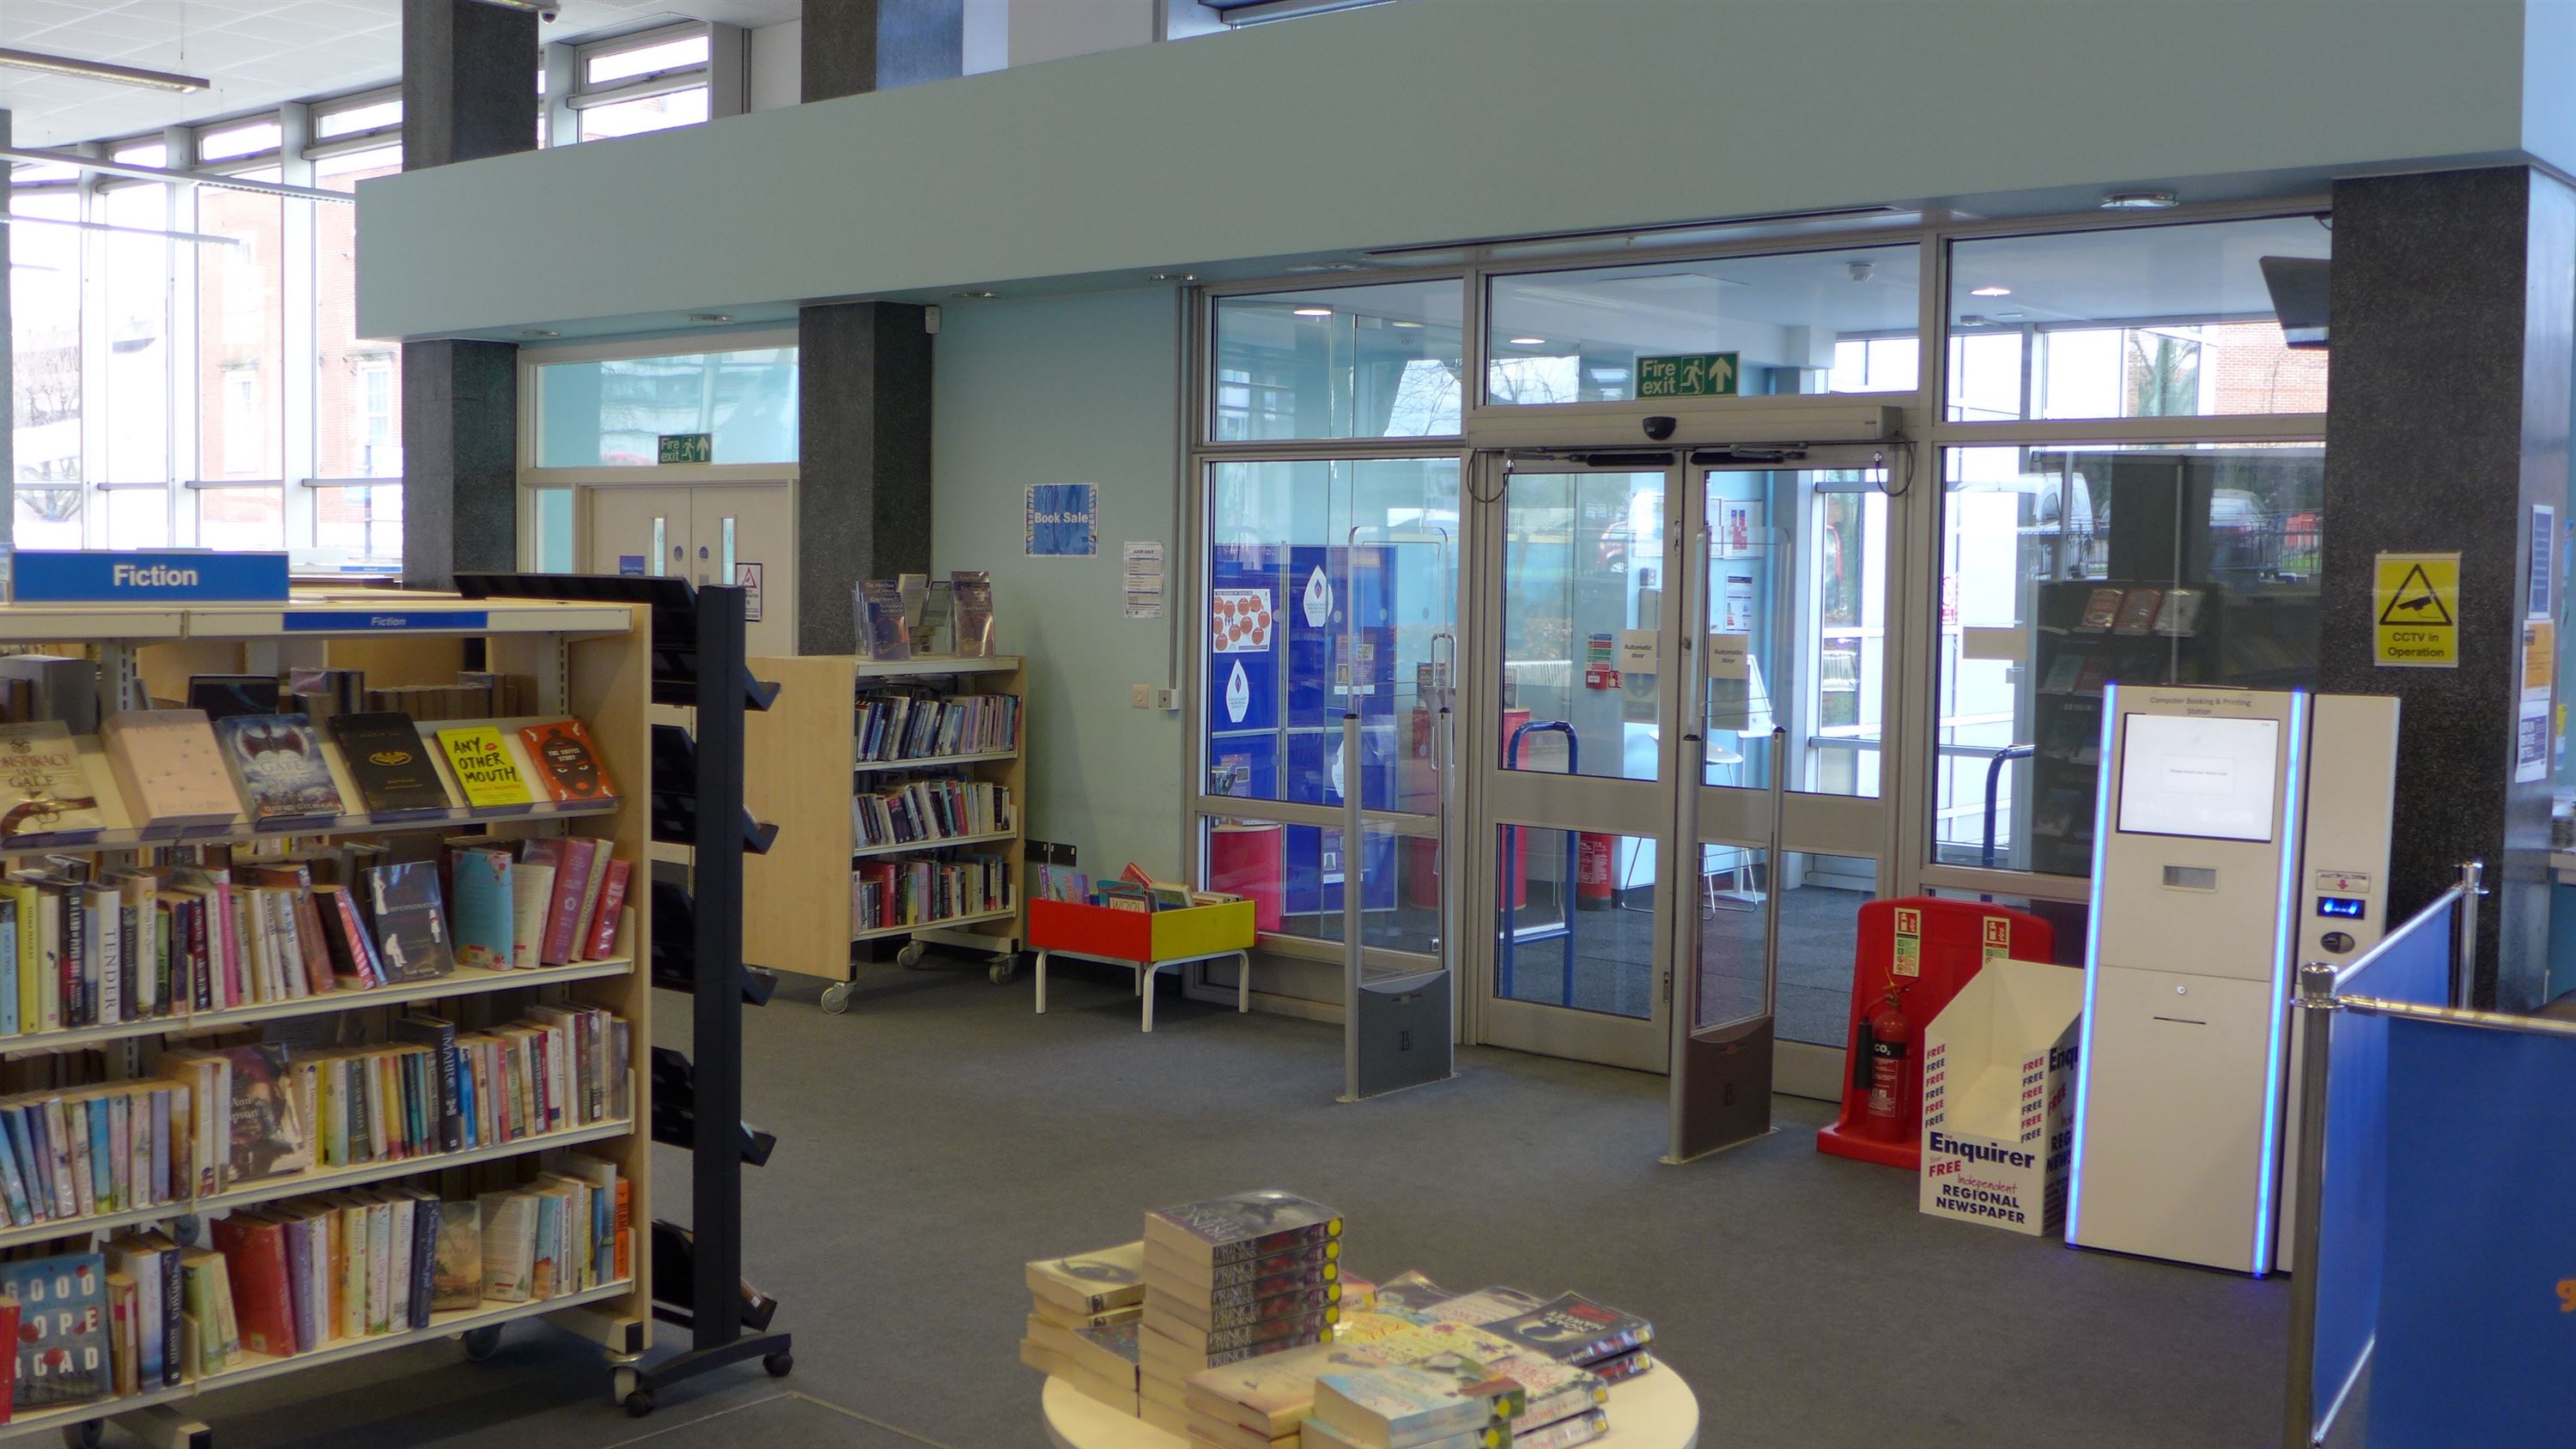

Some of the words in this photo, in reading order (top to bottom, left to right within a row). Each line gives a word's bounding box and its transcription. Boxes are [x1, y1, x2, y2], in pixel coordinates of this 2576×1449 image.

[1642, 360, 1676, 377] Fire
[1642, 377, 1676, 395] exit
[660, 437, 680, 450] Fire
[660, 450, 680, 463] exit
[1034, 512, 1060, 524] Book
[1062, 512, 1089, 524] Sale
[112, 564, 198, 586] Fiction
[370, 616, 407, 627] Fiction
[2392, 632, 2426, 642] CCTV
[2387, 646, 2445, 658] Operation
[2149, 696, 2185, 705] Computer
[2186, 697, 2215, 706] Booking
[2222, 699, 2252, 708] Printing
[453, 737, 481, 755] ANY
[459, 752, 506, 770] OTHER
[104, 927, 116, 1010] TENDER
[1927, 1044, 1946, 1060] FREE
[1926, 1058, 1946, 1073] FREE
[2023, 1057, 2044, 1073] FREE
[1926, 1071, 1945, 1088] FREE
[2022, 1071, 2044, 1087] FREE
[1925, 1085, 1944, 1101] FREE
[2022, 1085, 2043, 1101] FREE
[1925, 1100, 1944, 1115] FREE
[2021, 1099, 2043, 1116] FREE
[1924, 1113, 1944, 1129] FREE
[2020, 1113, 2042, 1130] FREE
[2020, 1127, 2041, 1144] FREE
[1929, 1131, 2035, 1169] Enquirer
[1929, 1160, 1961, 1178] FREE
[1957, 1173, 2019, 1195] Independent
[1942, 1184, 2020, 1209] REGIONAL
[1936, 1197, 2026, 1224] NEWSPAPER
[1215, 1240, 1258, 1258] PRINCE
[1214, 1304, 1255, 1322] PRINCE
[32, 1307, 98, 1339] OPE
[1209, 1326, 1250, 1345] PRINCE
